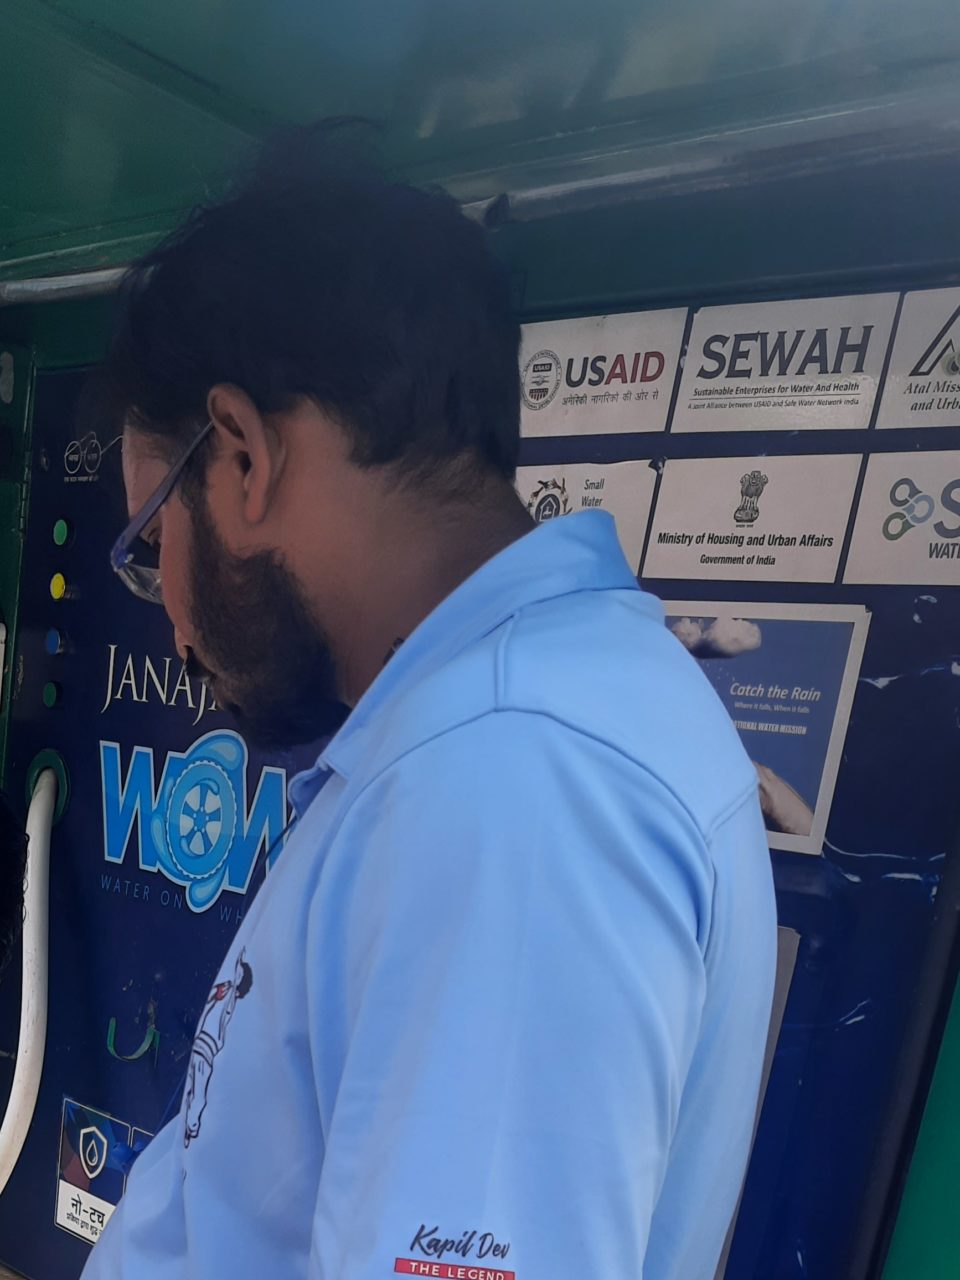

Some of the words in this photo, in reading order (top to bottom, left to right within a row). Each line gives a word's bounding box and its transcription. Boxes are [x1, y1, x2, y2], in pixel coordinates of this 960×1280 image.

[696, 325, 875, 380] SEWAH
[565, 351, 665, 388] USAID
[693, 387, 734, 397] Sustainable
[735, 385, 776, 396] Enterprises
[778, 384, 789, 393] for
[791, 384, 814, 393] Water
[815, 383, 831, 392] And
[833, 382, 860, 391] Health
[903, 381, 931, 394] Atal
[910, 398, 935, 411] and
[937, 397, 960, 410] Urb
[584, 478, 605, 490] Small
[581, 496, 603, 507] Water
[657, 532, 693, 546] Ministry
[695, 533, 706, 545] of
[707, 533, 744, 547] Housing
[746, 534, 764, 546] and
[767, 534, 796, 547] Urban
[799, 534, 834, 547] Affairs
[700, 554, 745, 565] Government
[746, 555, 755, 565] of
[756, 555, 776, 566] India
[100, 644, 217, 727] JANAJ
[730, 682, 765, 697] Catch
[767, 685, 788, 699] the
[791, 687, 821, 702] Rain
[100, 874, 150, 901] WATER
[160, 890, 183, 909] ON
[410, 1224, 478, 1259] Kapil
[476, 1232, 510, 1259] Dev
[410, 1262, 440, 1276] THE
